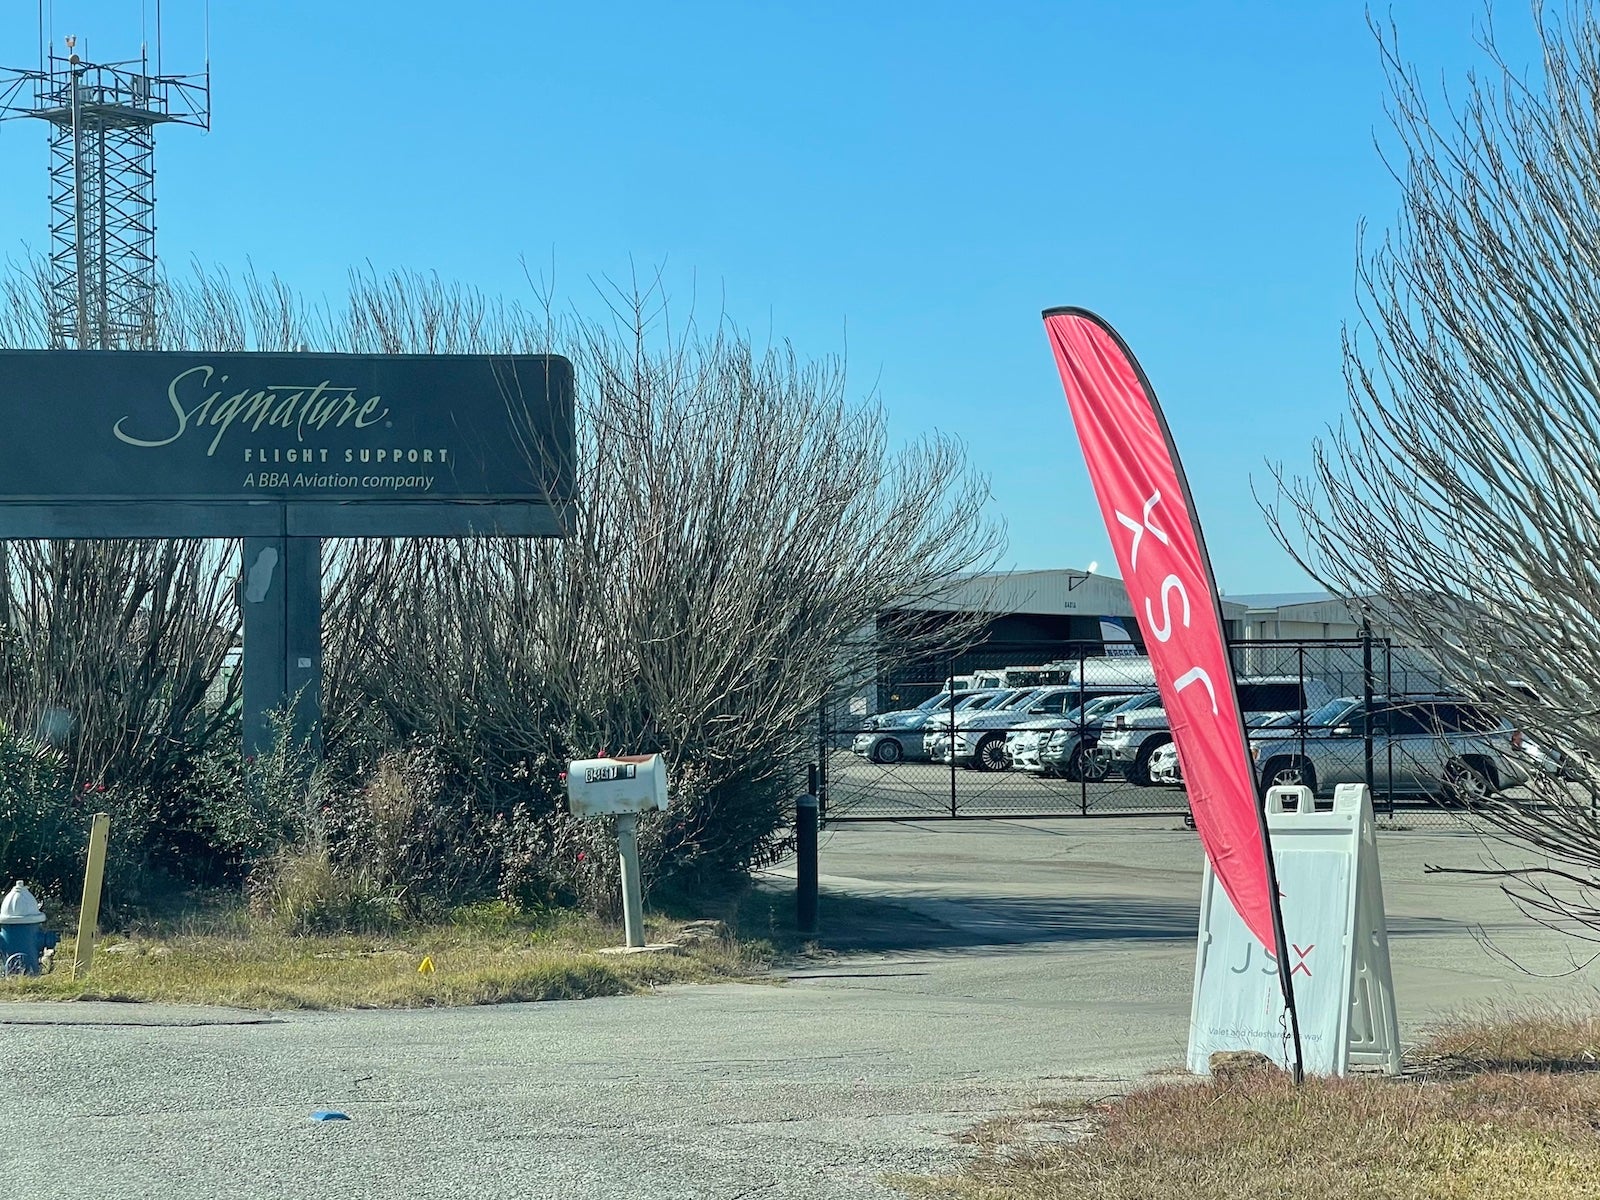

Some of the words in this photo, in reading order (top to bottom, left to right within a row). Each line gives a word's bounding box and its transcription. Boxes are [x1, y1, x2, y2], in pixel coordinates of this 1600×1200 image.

[113, 364, 390, 457] Signature
[244, 448, 330, 463] FLIGHT
[344, 448, 450, 463] SUPPORT
[243, 473, 255, 488] A
[258, 473, 290, 488] BBA
[293, 472, 359, 488] Aviation
[362, 475, 434, 491] company
[1115, 488, 1219, 716] JSX
[1208, 1027, 1229, 1036] Valet
